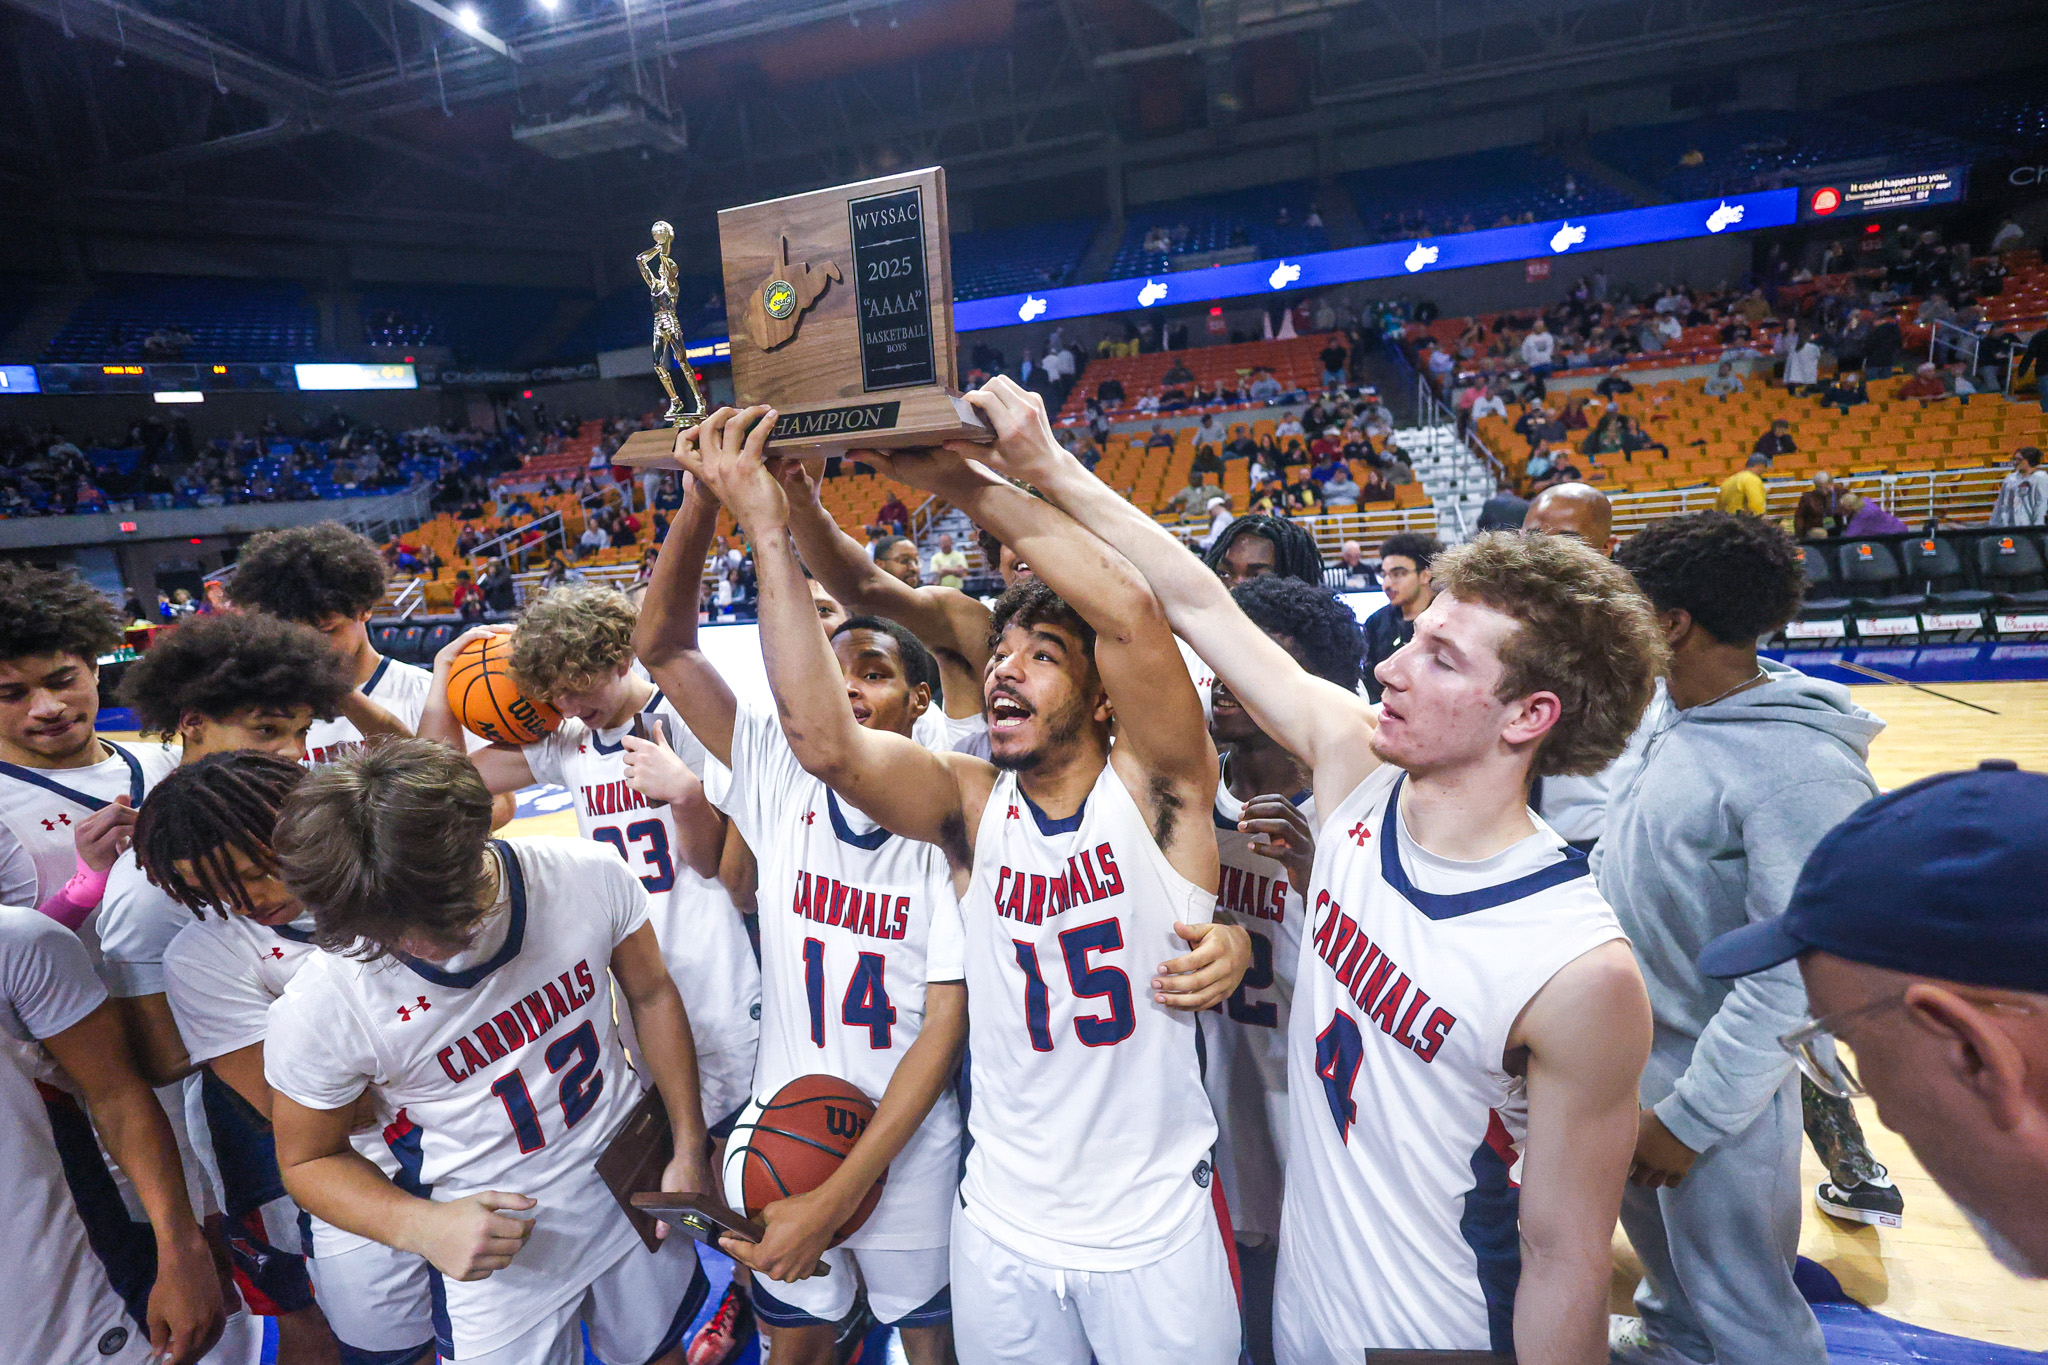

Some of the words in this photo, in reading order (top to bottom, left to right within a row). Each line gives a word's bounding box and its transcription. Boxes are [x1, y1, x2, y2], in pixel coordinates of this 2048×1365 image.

[1850, 183, 1858, 192] It
[1859, 180, 1883, 191] could
[1884, 177, 1916, 189] happen
[1918, 175, 1927, 184] to
[1928, 173, 1948, 183] you.
[1879, 188, 1891, 196] the
[1891, 183, 1935, 195] WVLOTTERY
[855, 203, 918, 231] WVSSAC
[867, 256, 912, 282] 2025
[866, 324, 927, 346] BASKETBALL
[886, 342, 907, 354] BOYS
[770, 407, 884, 437] HAMPION
[580, 779, 650, 817] ARDINA
[994, 841, 1125, 927] CARINALS
[1216, 863, 1289, 924] INALS
[802, 936, 897, 1050] 14
[1011, 916, 1137, 1053] 15
[1312, 888, 1458, 1064] CARDINALS
[436, 958, 596, 1084] CARDINALS
[490, 1018, 604, 1155] 12
[1314, 1006, 1365, 1149] 4
